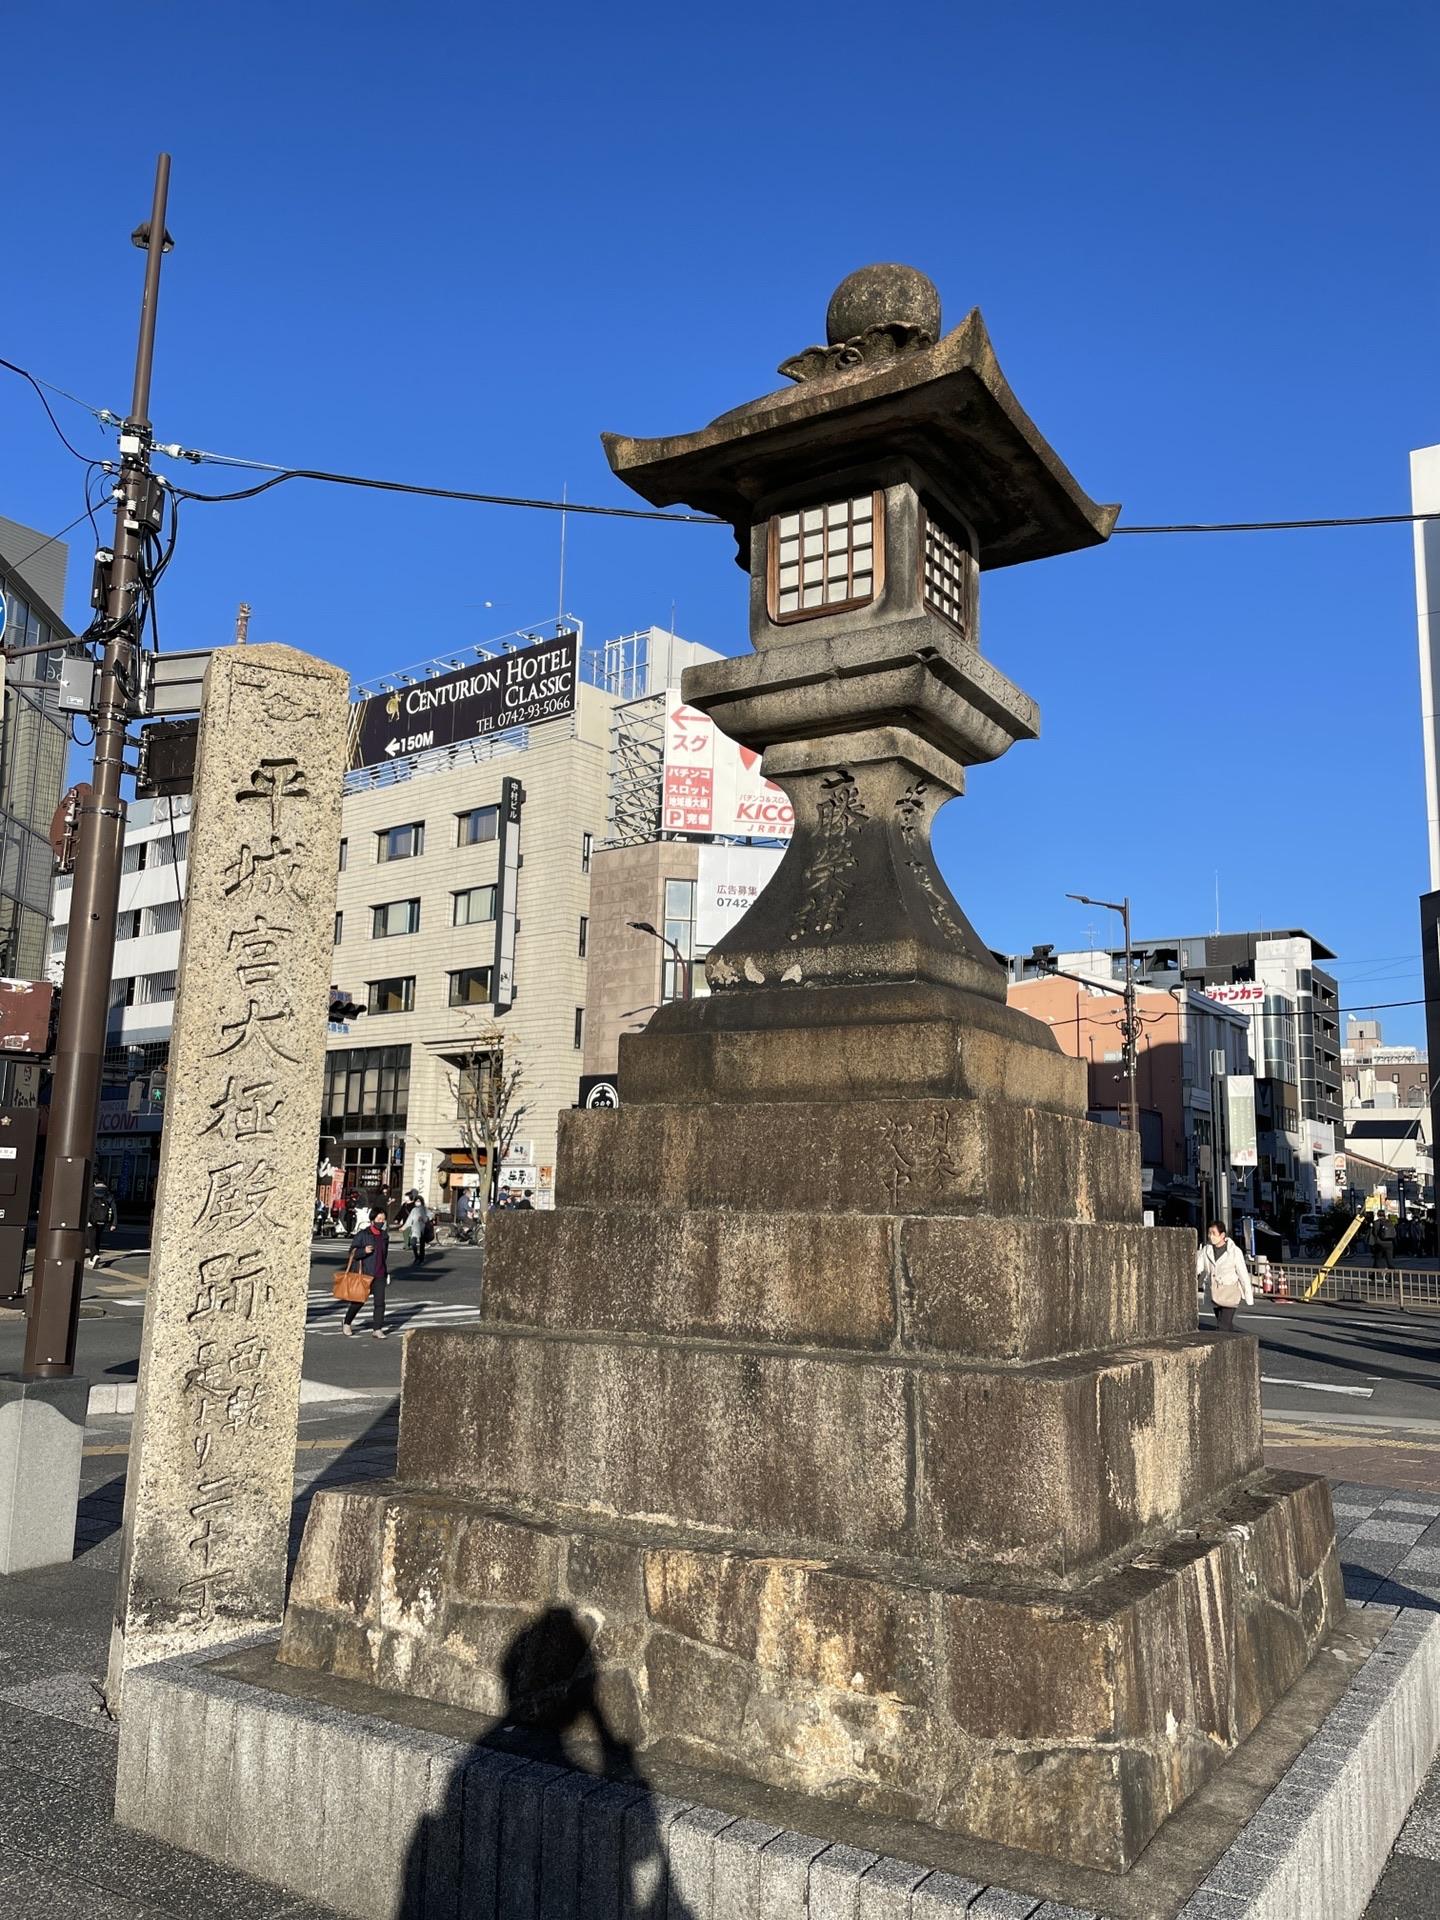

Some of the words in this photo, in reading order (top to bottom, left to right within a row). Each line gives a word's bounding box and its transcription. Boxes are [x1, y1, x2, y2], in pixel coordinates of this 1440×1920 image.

[406, 669, 501, 715] CENTURION
[506, 648, 571, 685] HOTEL
[505, 673, 571, 707] CLASSIC
[498, 695, 571, 727] 0742-93-5066
[400, 731, 434, 752] 150M
[673, 734, 708, 752] スグ
[668, 767, 710, 779] パチンコ
[668, 785, 710, 795] スロット
[670, 811, 682, 825] P
[717, 885, 758, 896] 広告募集
[1206, 986, 1263, 1001] ジャンカラ
